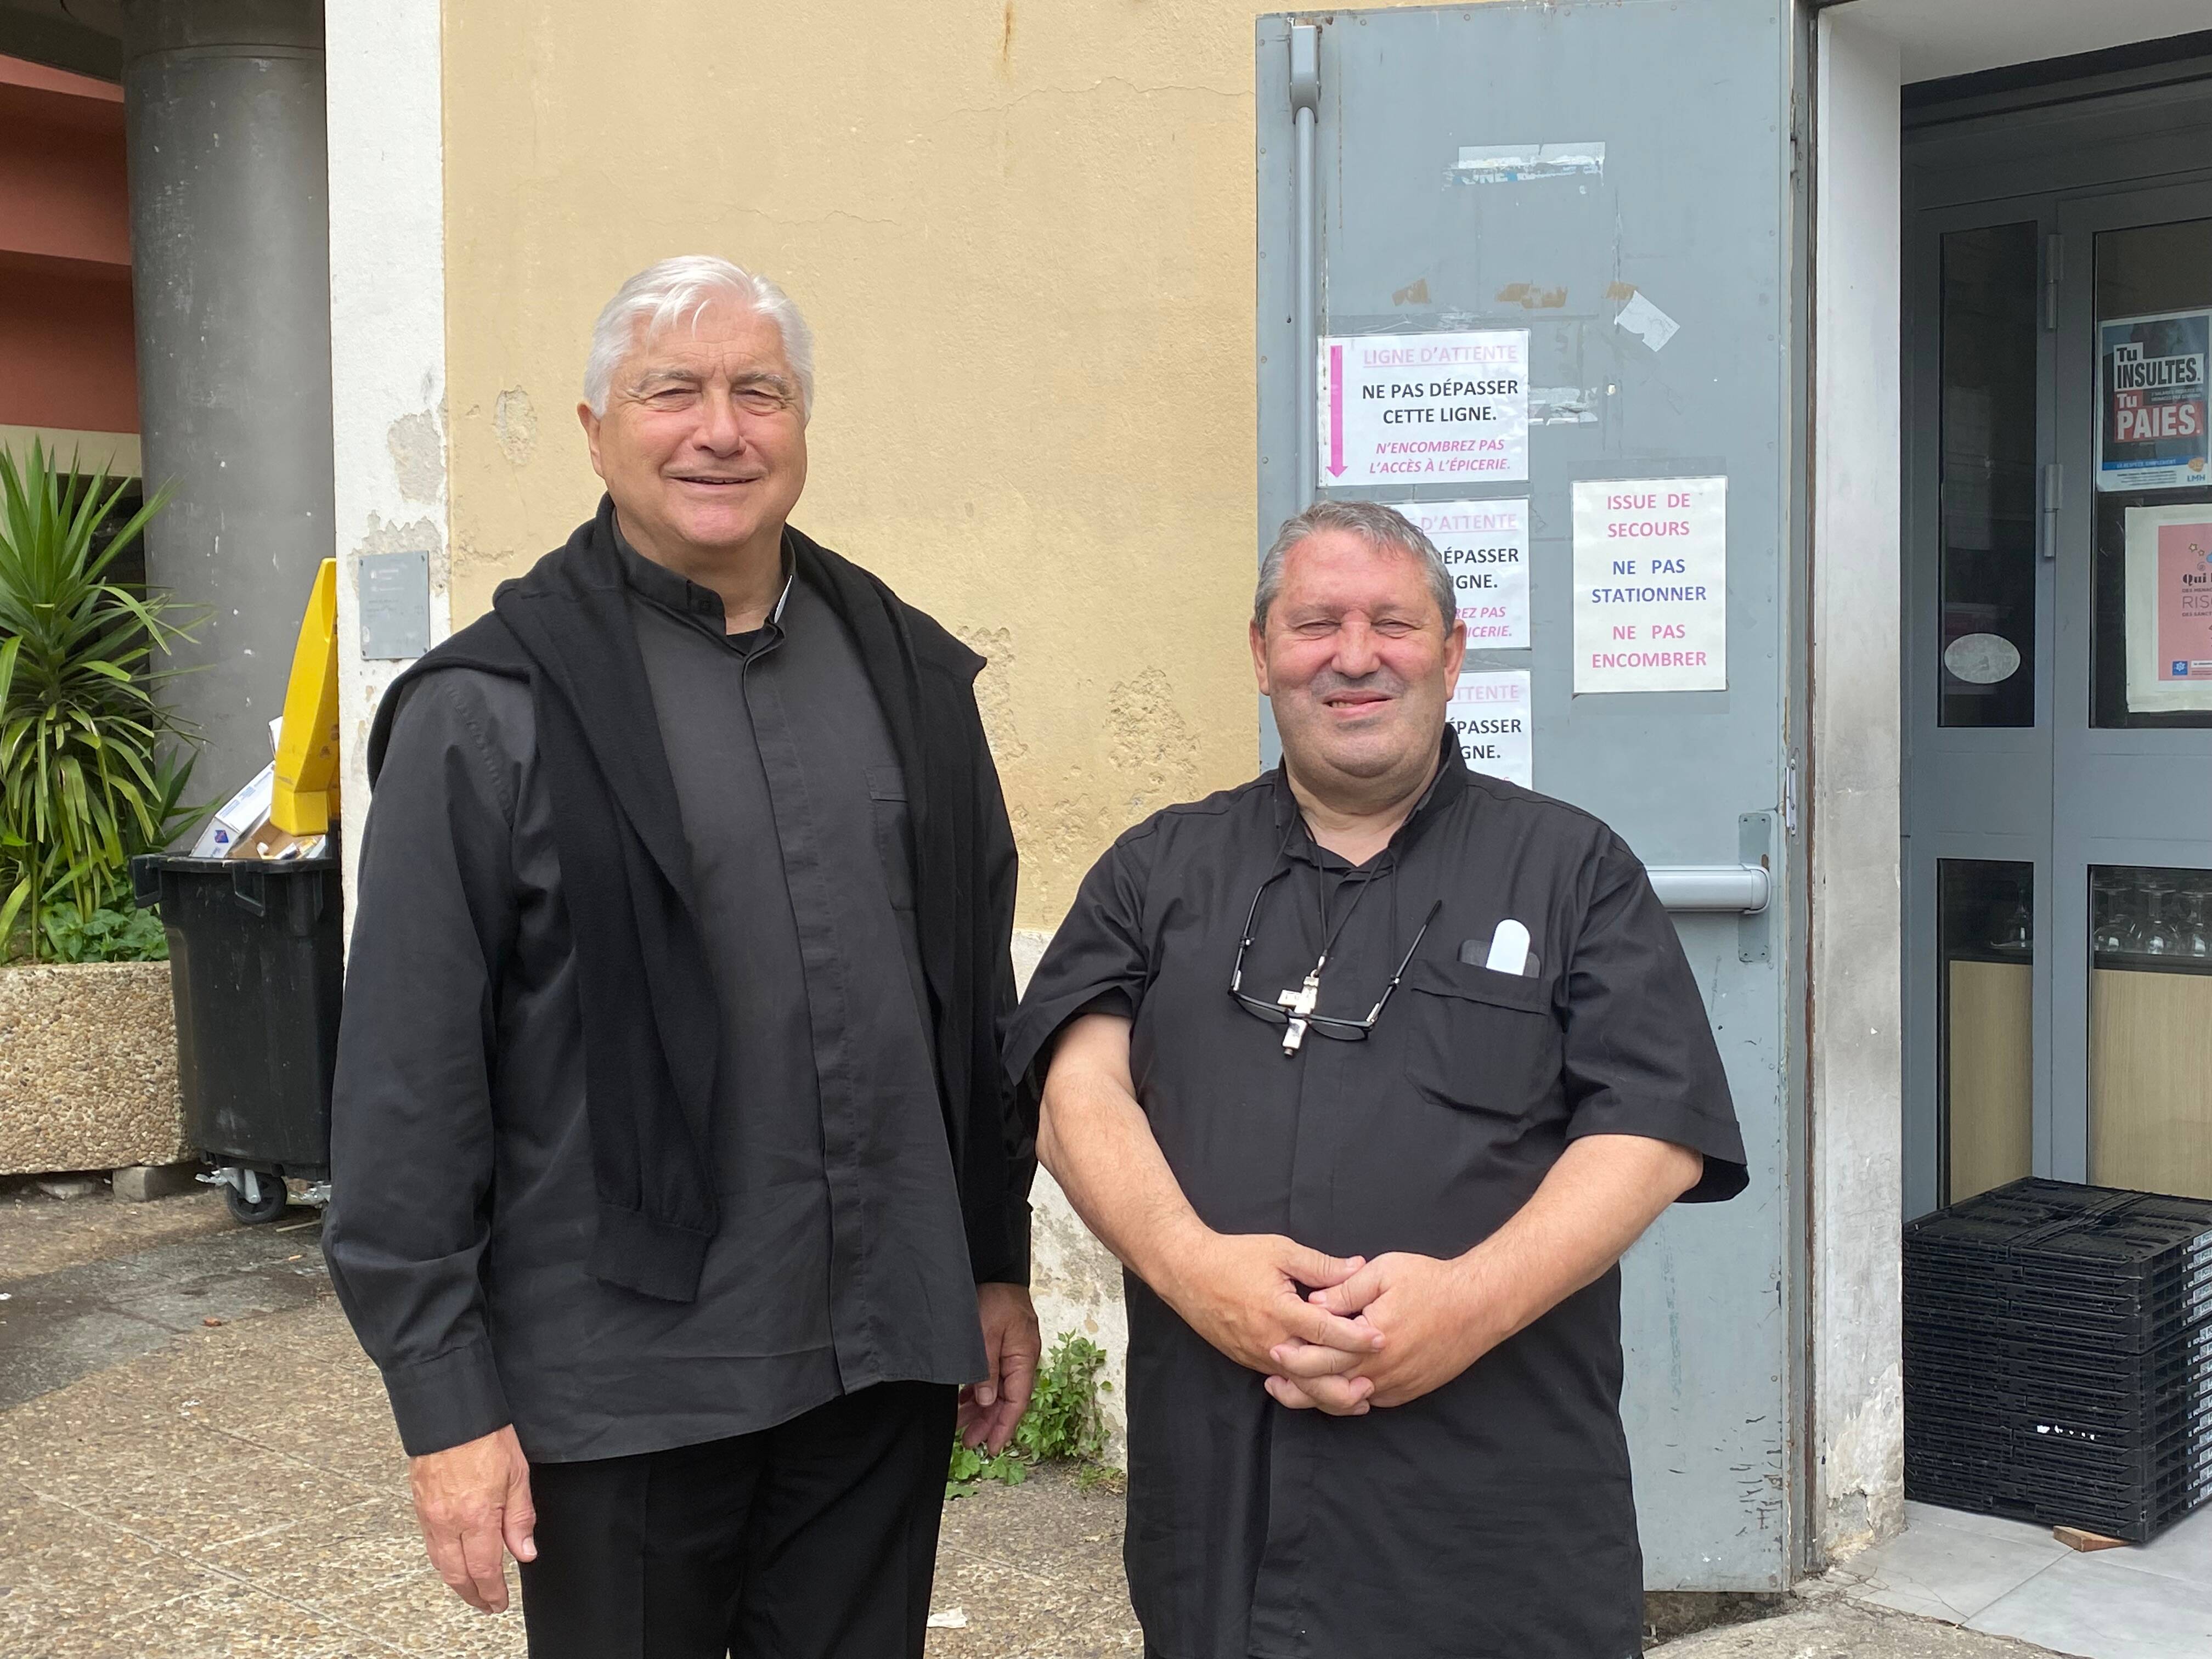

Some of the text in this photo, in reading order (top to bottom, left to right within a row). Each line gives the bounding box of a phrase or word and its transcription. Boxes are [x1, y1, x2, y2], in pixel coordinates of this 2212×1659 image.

[1363, 346, 1517, 365] LIGNE D'ATTENTE
[2117, 347, 2137, 362] Tu
[2117, 357, 2200, 389] INSULTES.
[1362, 379, 1519, 399] NE PAS DÉPASSER
[2117, 393, 2137, 409] Tu
[1383, 407, 1497, 424] CETTE LIGNE.
[2117, 404, 2200, 440] PAIES.
[1376, 439, 1505, 454] N'ENCOMBREZ PAS
[1370, 457, 1510, 473] L'ACCÈS À L'ÉPICERIE.
[1607, 493, 1691, 510] ISSUE DE
[1421, 514, 1516, 531] D'ATTENTE
[1607, 521, 1690, 538] SECOURS
[1444, 546, 1519, 564] ÉPASSER
[1613, 558, 1686, 575] NE PAS
[2182, 573, 2207, 586] Qui
[1592, 586, 1707, 603] STATIONNER
[2182, 595, 2212, 608] RIS
[1480, 606, 1506, 618] PAS
[1467, 625, 1512, 637] ICERIE.
[1613, 624, 1686, 640] NE PAS
[1592, 652, 1707, 668] ENCOMBRER
[1455, 685, 1519, 701] TTENTE
[1448, 717, 1521, 734] PASSER
[1461, 745, 1501, 759] GNE.
